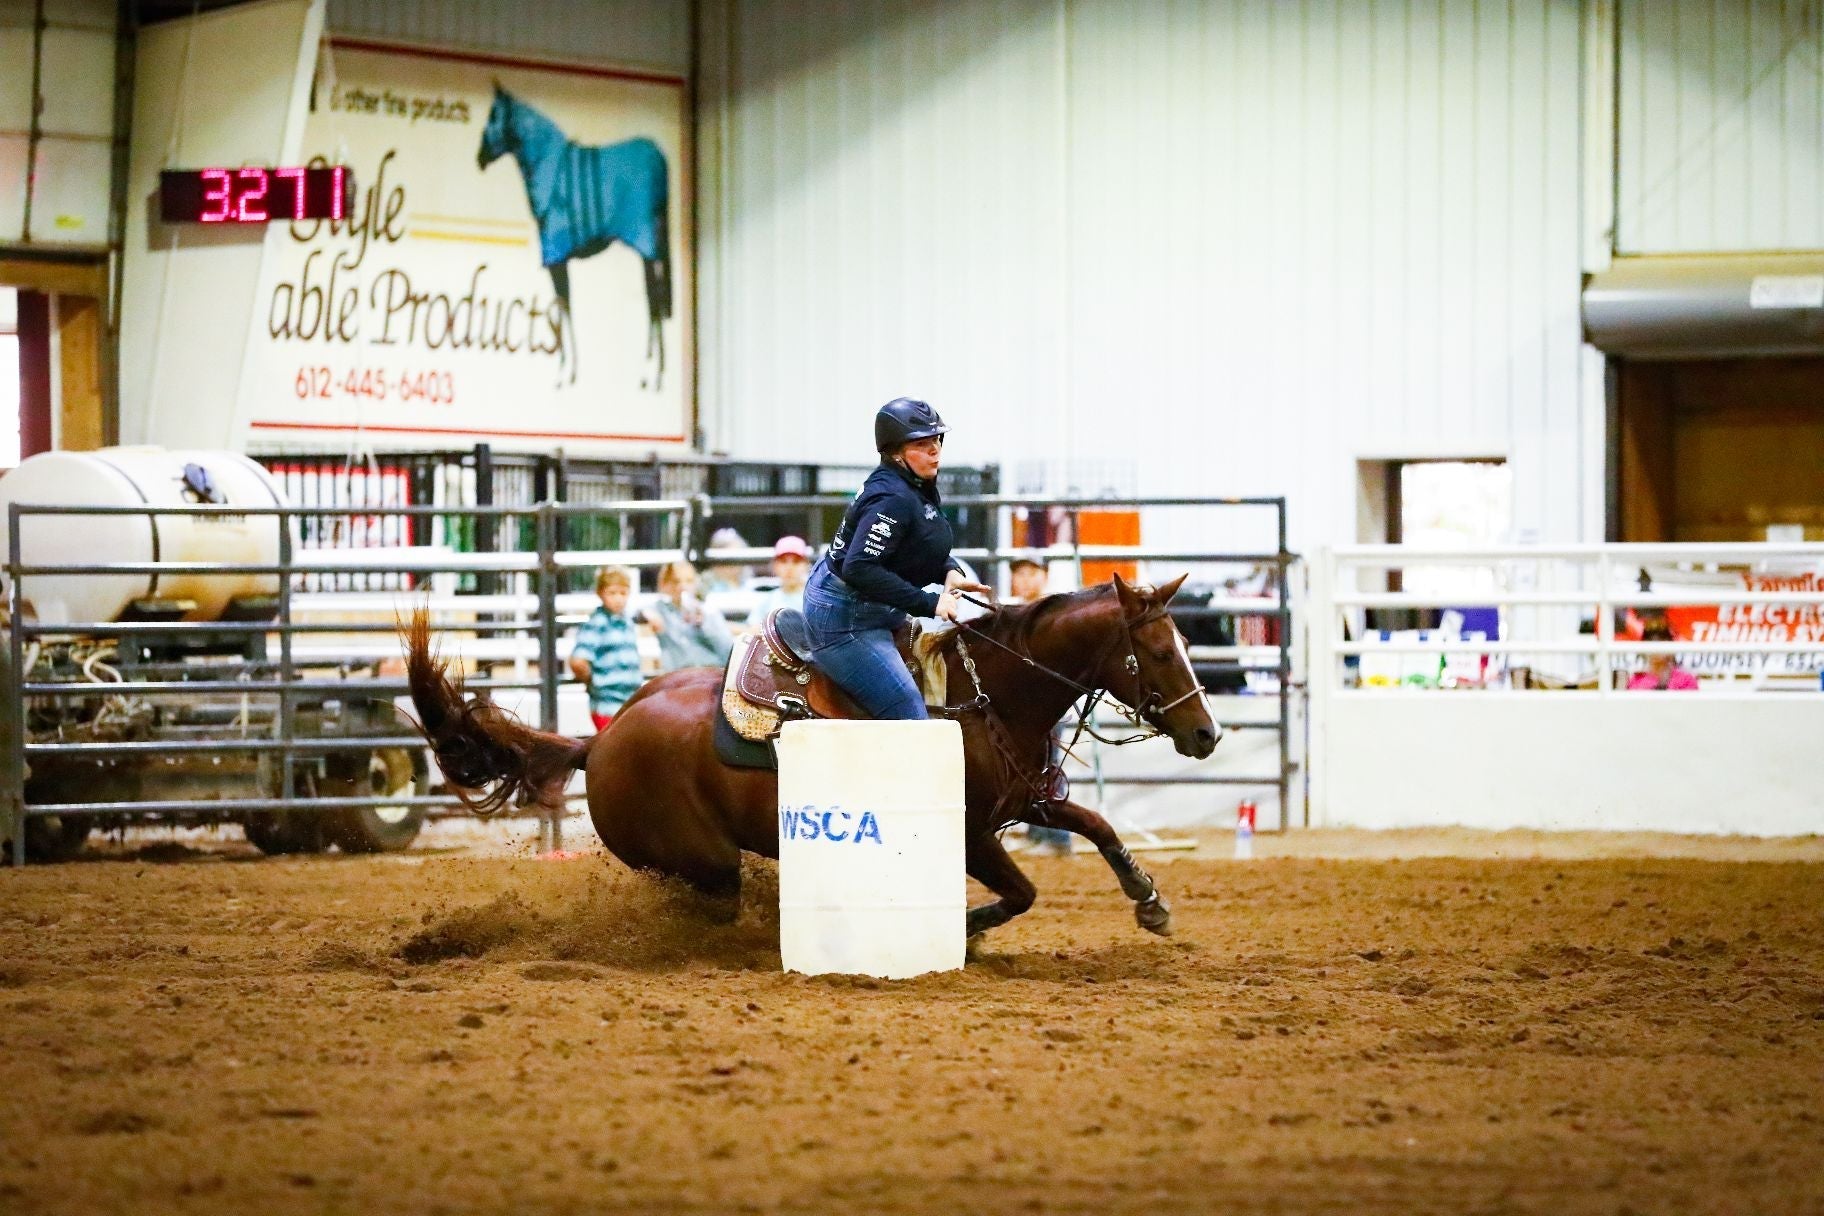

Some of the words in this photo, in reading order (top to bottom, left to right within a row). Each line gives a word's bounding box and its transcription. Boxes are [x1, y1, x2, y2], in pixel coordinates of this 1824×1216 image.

[410, 96, 471, 127] products
[202, 166, 344, 221] 3.271
[269, 249, 359, 342] able
[370, 262, 566, 354] Products
[295, 366, 456, 404] 612-445-6403
[1691, 621, 1788, 642] TIMING
[781, 804, 883, 844] WSCA
